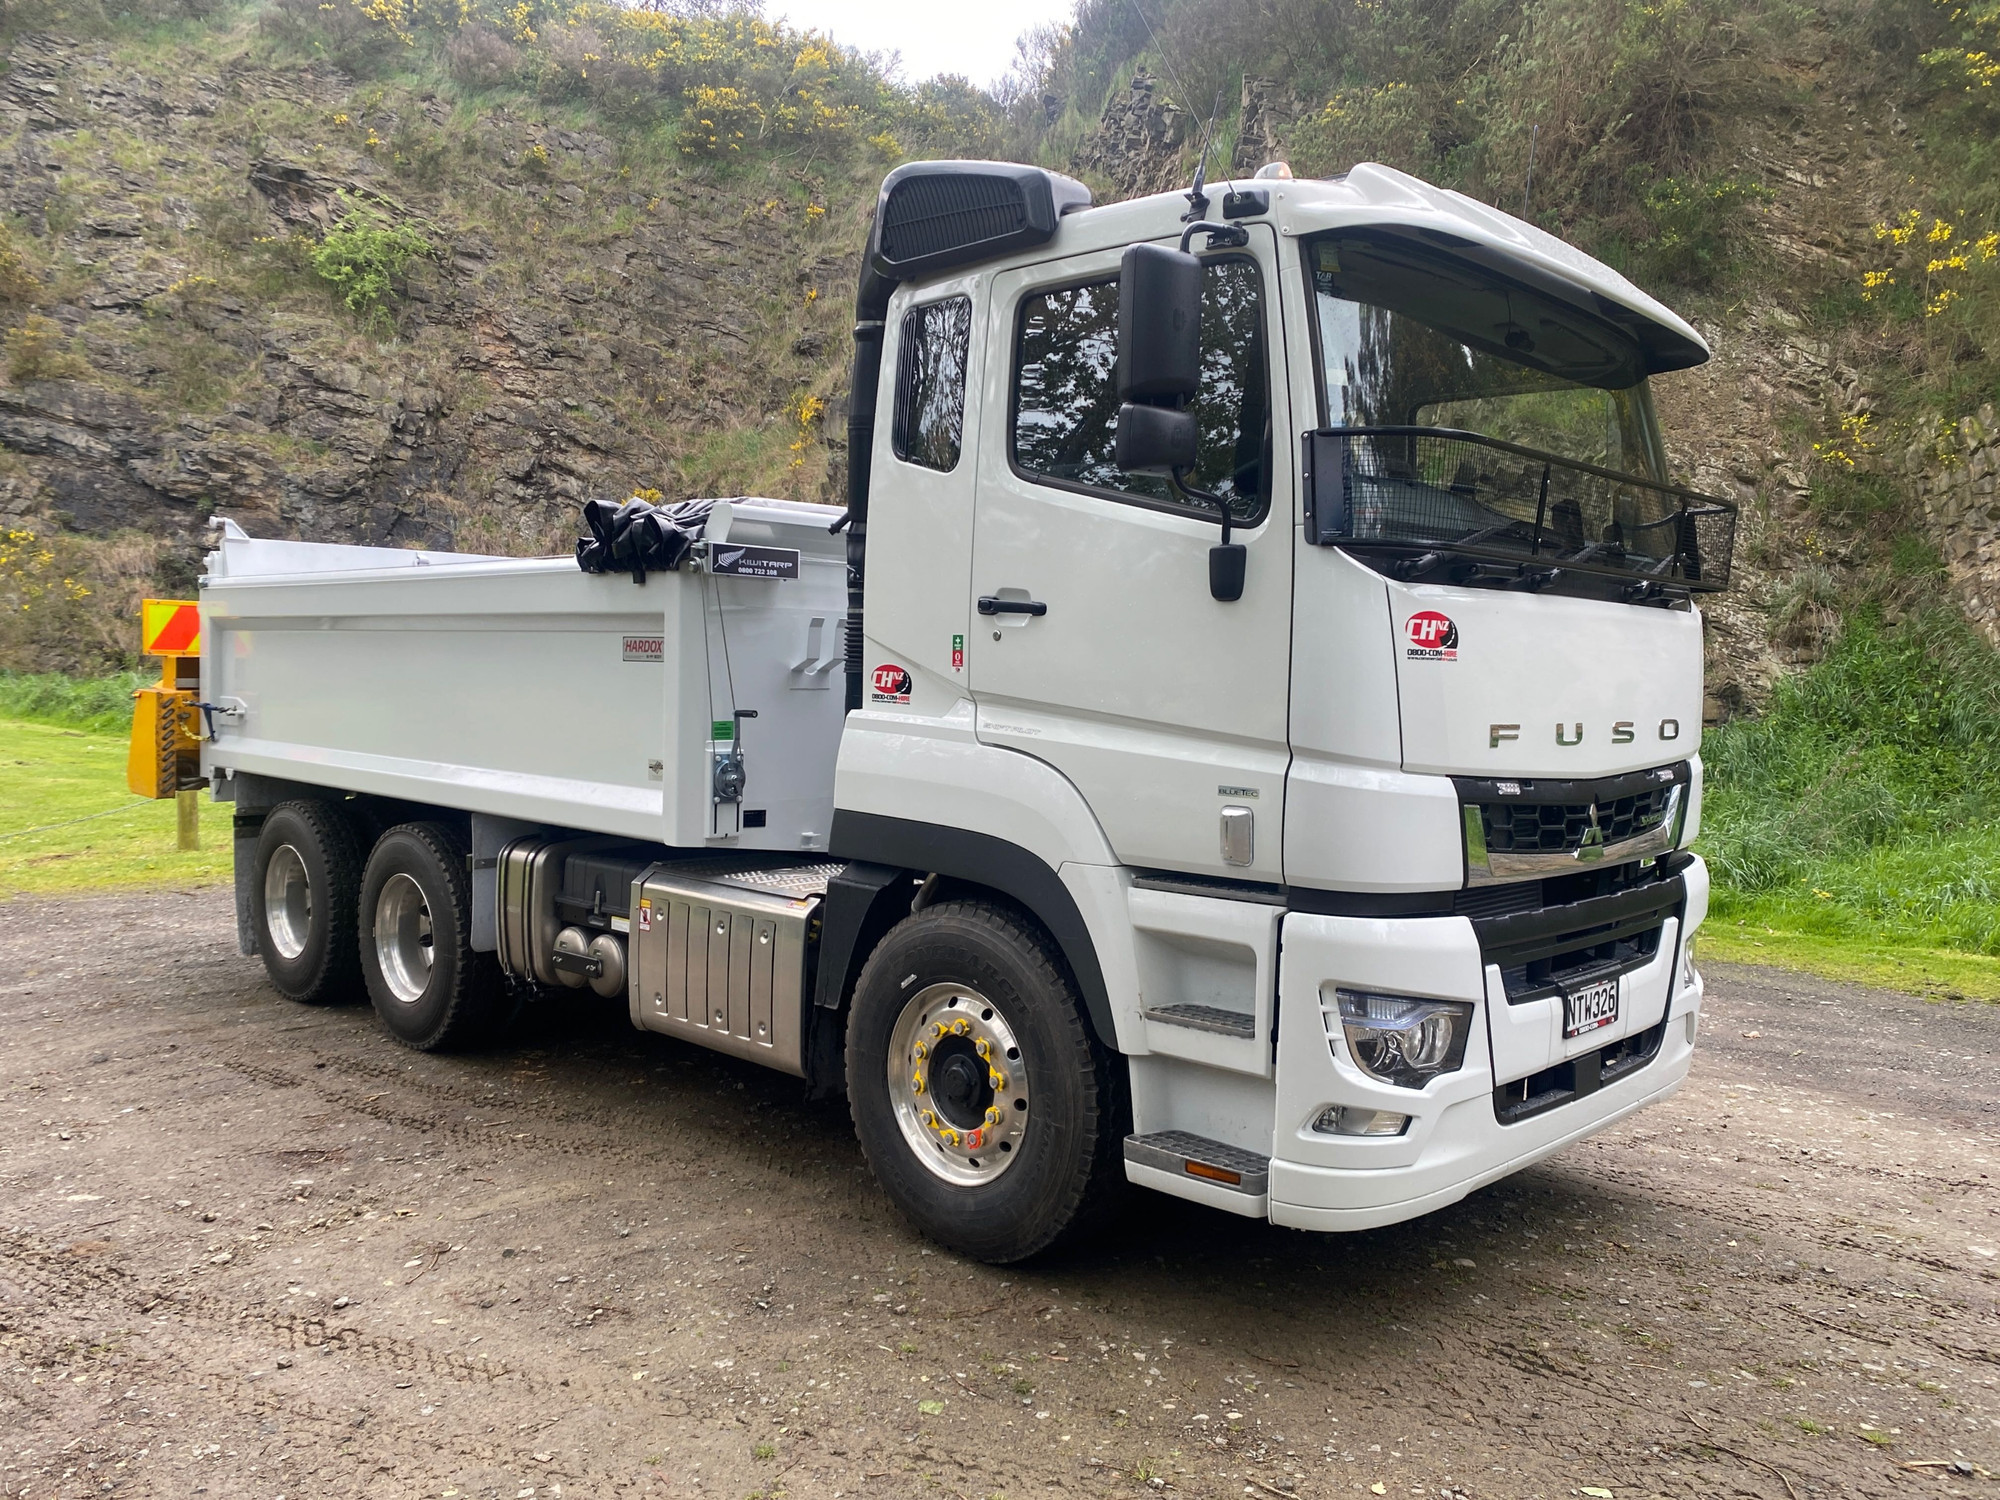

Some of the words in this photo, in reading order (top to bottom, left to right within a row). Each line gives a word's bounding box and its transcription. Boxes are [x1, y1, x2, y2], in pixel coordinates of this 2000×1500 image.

[738, 558, 793, 569] KIWITARP
[624, 639, 663, 653] HARDOX
[1489, 718, 1680, 750] FUSO
[1569, 984, 1616, 1026] NTW326
